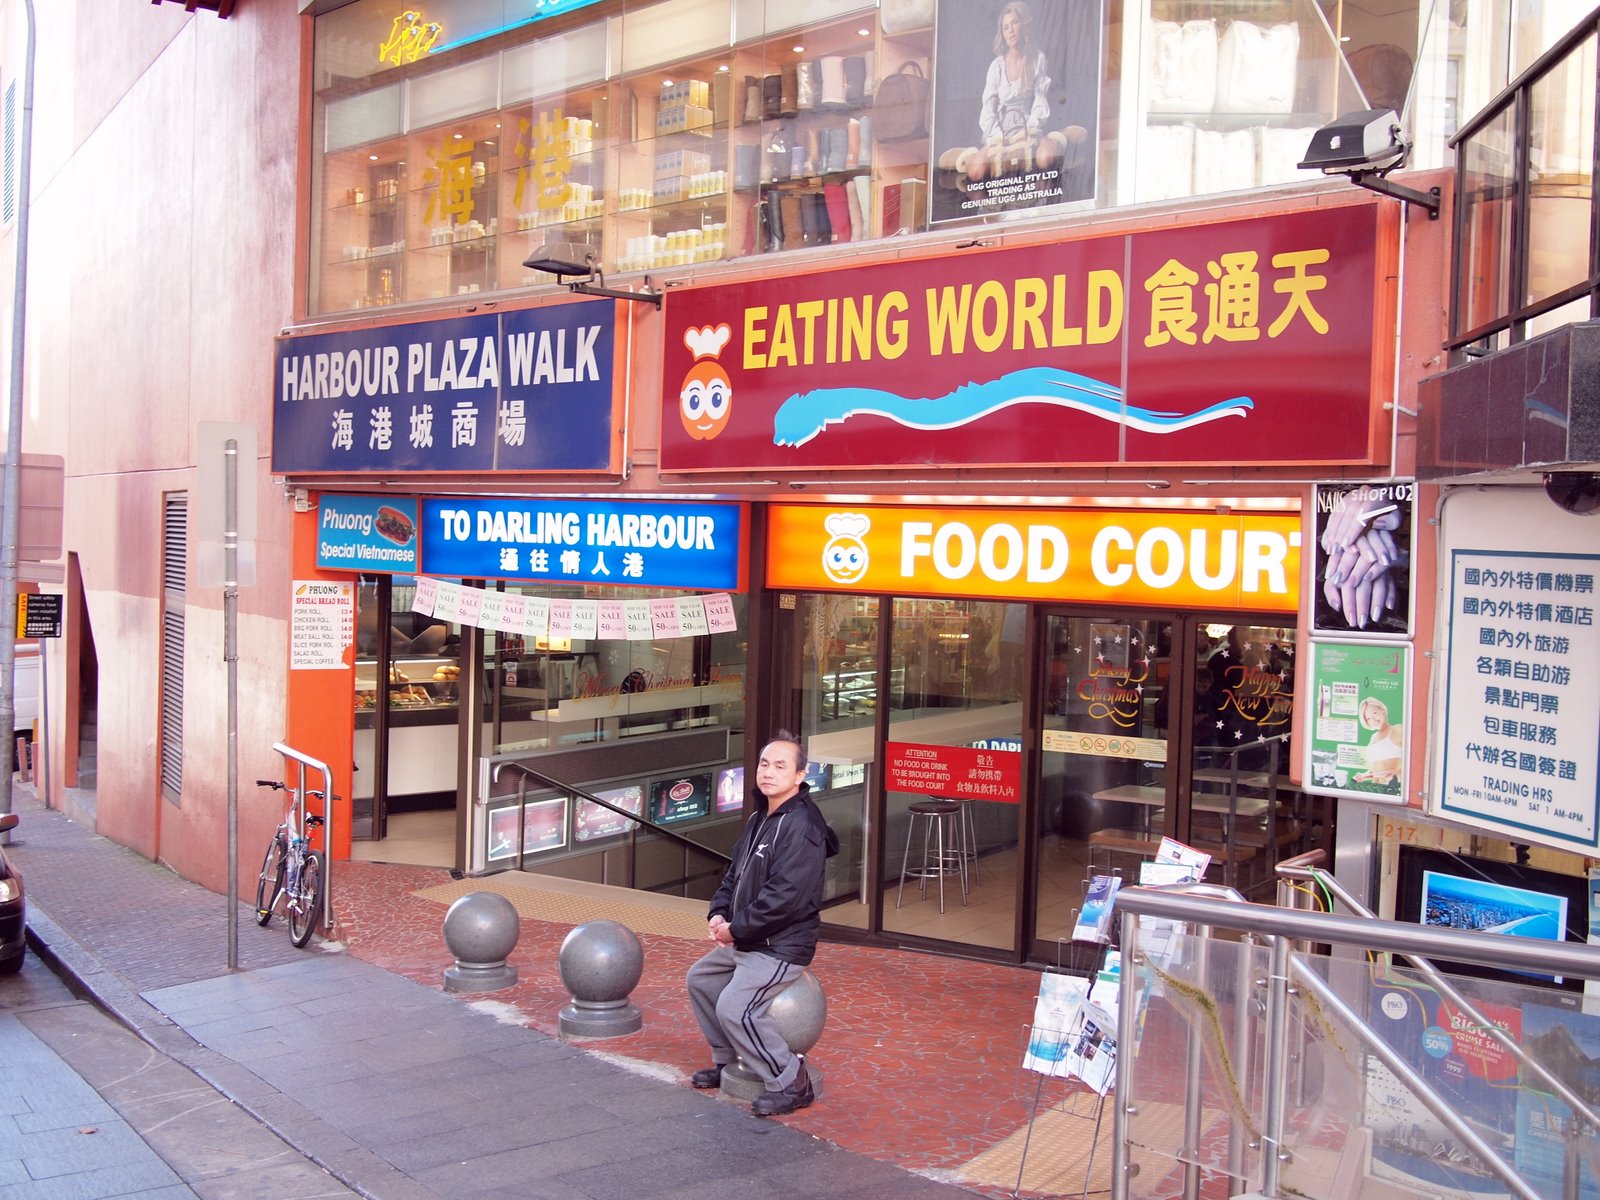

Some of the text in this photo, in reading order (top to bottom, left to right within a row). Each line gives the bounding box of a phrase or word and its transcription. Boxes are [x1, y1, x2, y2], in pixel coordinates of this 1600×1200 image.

[967, 170, 1058, 192] UGG ORIGINAL PTY LTD
[961, 187, 1063, 209] GENUINE UGG AUSTRALIA
[987, 185, 1023, 197] TRADING
[1144, 248, 1331, 348] 食通天
[743, 269, 1124, 371] EATING WORLD
[282, 325, 601, 402] HARBOUR PLAZA WALK
[332, 399, 527, 452] 海港城商場
[323, 508, 372, 536] Phuong
[440, 509, 715, 550] TO DARLING HARBOUR
[320, 542, 414, 562] Special Vietnamese
[901, 521, 1301, 593] FOOD COUR
[1465, 568, 1594, 594] 國內外特價機票
[309, 586, 338, 595] PHUONG
[461, 599, 478, 608] SALE
[505, 606, 524, 614] SALE
[710, 606, 730, 616] SALE
[1463, 597, 1593, 626] 國內外特價酒店
[528, 609, 544, 617] SALE
[553, 611, 572, 619] SALE
[601, 612, 621, 620] SALE
[655, 611, 676, 619] SALE
[682, 610, 702, 619] SALE
[1480, 627, 1570, 654] 國內外旅游
[1476, 656, 1570, 685] 各類自助游
[1077, 678, 1139, 703] Christmas
[1218, 689, 1261, 720] New
[1485, 686, 1559, 714] 景點門票
[1483, 716, 1557, 745] 包車服務
[905, 749, 938, 758] ATTENTION
[977, 754, 993, 766] 敬告
[904, 760, 920, 769] FOOD
[921, 761, 930, 769] OR
[930, 762, 948, 770] DRINK
[901, 769, 908, 777] BE
[909, 770, 936, 779] BROUGHT
[936, 772, 950, 780] INTO
[897, 779, 945, 790] THE FOOD COURT
[1483, 776, 1553, 802] TRADING HRS
[1454, 786, 1469, 795] MON
[1528, 803, 1540, 812] SAT
[1384, 824, 1416, 840] 217
[1387, 1001, 1403, 1009] P&O
[1426, 1039, 1449, 1051] 50%
[1456, 1032, 1484, 1046] CRUISE
[1387, 1095, 1406, 1107] P&O
